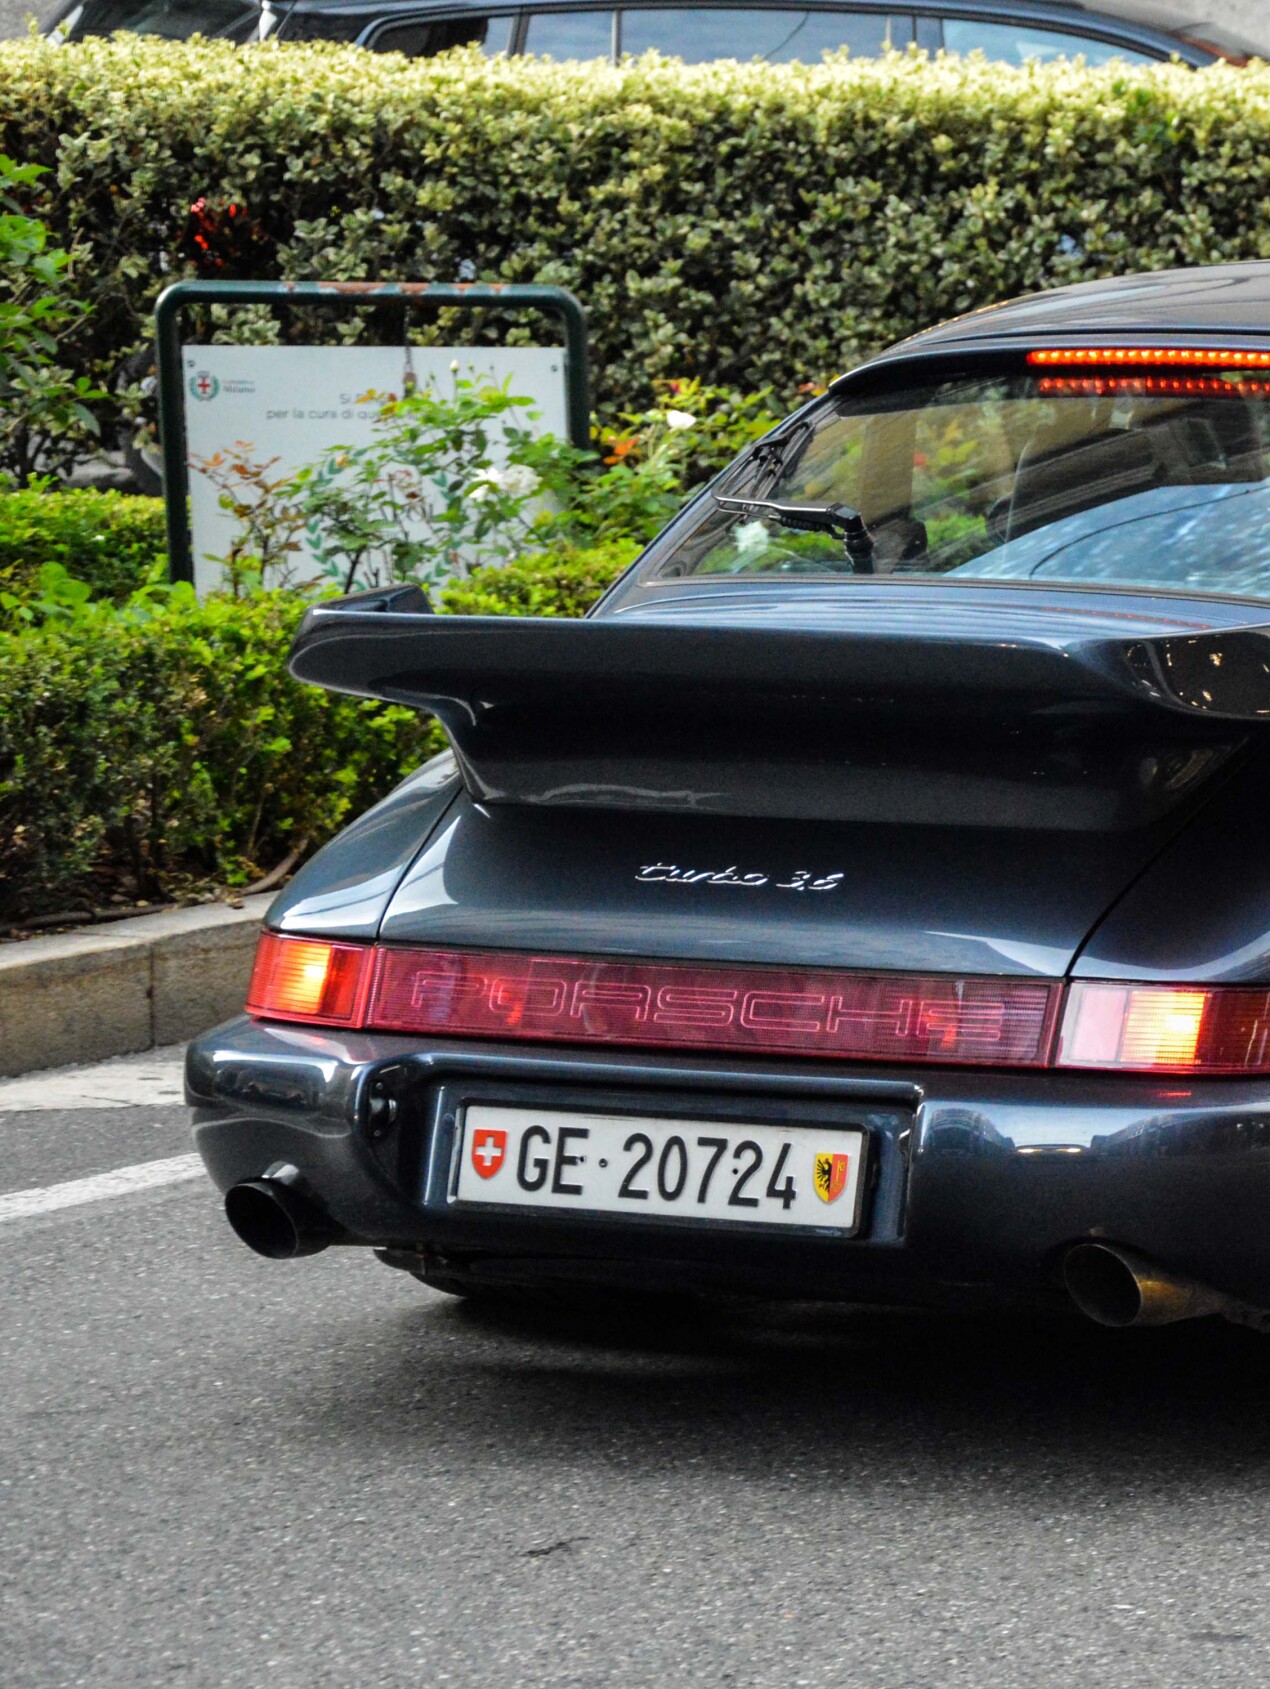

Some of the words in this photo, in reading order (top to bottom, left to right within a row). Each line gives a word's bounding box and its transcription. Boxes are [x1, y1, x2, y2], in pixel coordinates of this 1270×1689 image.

[266, 409, 288, 420] per
[292, 407, 305, 419] la
[308, 409, 338, 419] cura
[340, 407, 352, 419] di
[635, 863, 768, 887] turbo
[411, 970, 1004, 1041] PORSCHE
